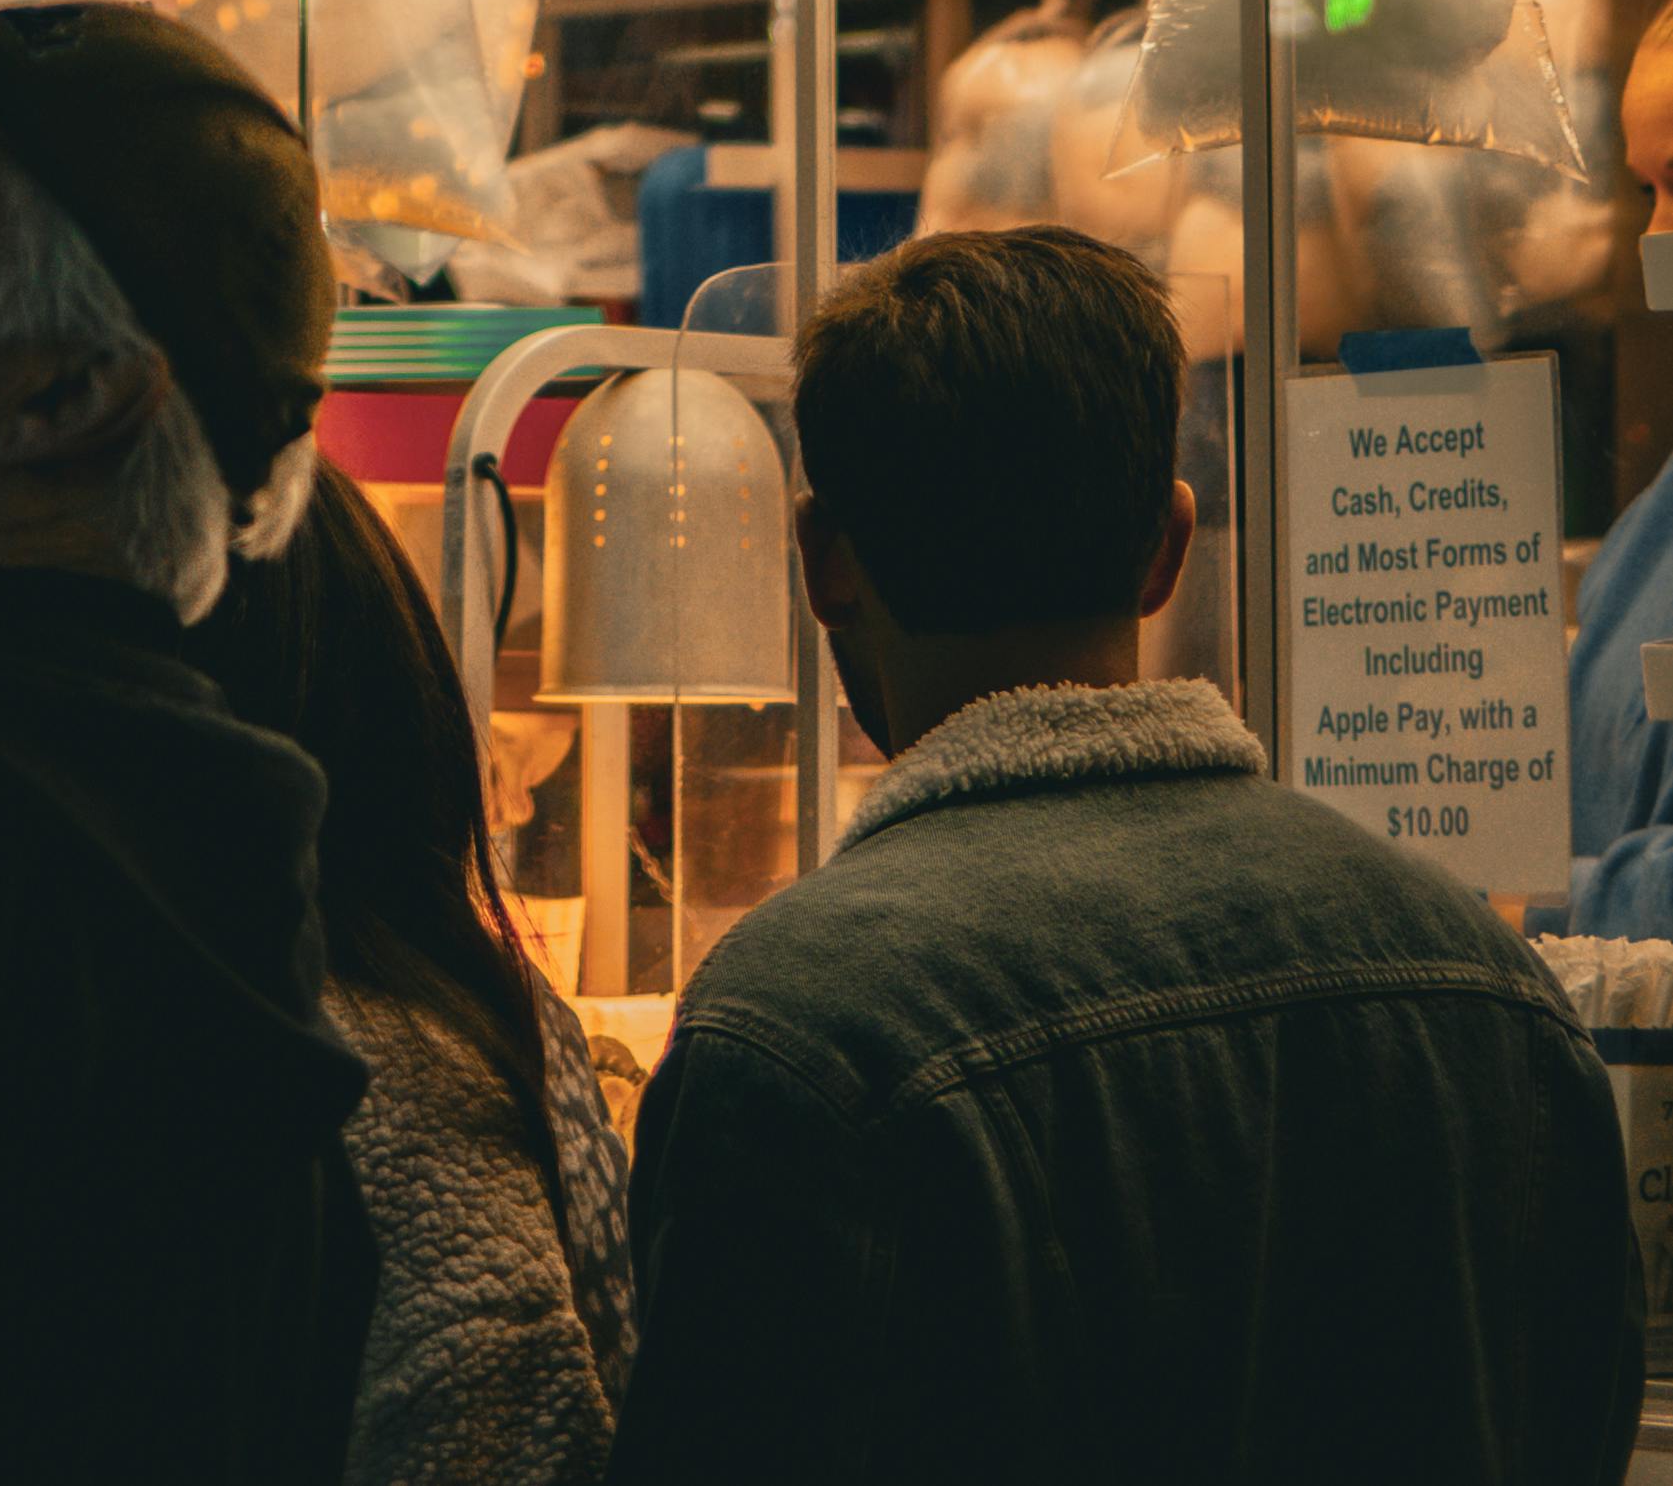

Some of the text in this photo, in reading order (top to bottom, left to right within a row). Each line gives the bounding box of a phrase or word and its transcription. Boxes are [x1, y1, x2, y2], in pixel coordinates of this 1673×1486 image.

[1349, 421, 1485, 458] We Accept
[1332, 478, 1508, 518] Cash, Credits,
[1306, 532, 1541, 575] and Most Forms of
[1303, 587, 1549, 627] Electronic Payment
[1365, 643, 1483, 680] Including
[1317, 698, 1538, 741] Apple Pay, with a
[1304, 750, 1555, 790] Minimum Charge of
[1387, 806, 1469, 838] $10.00
